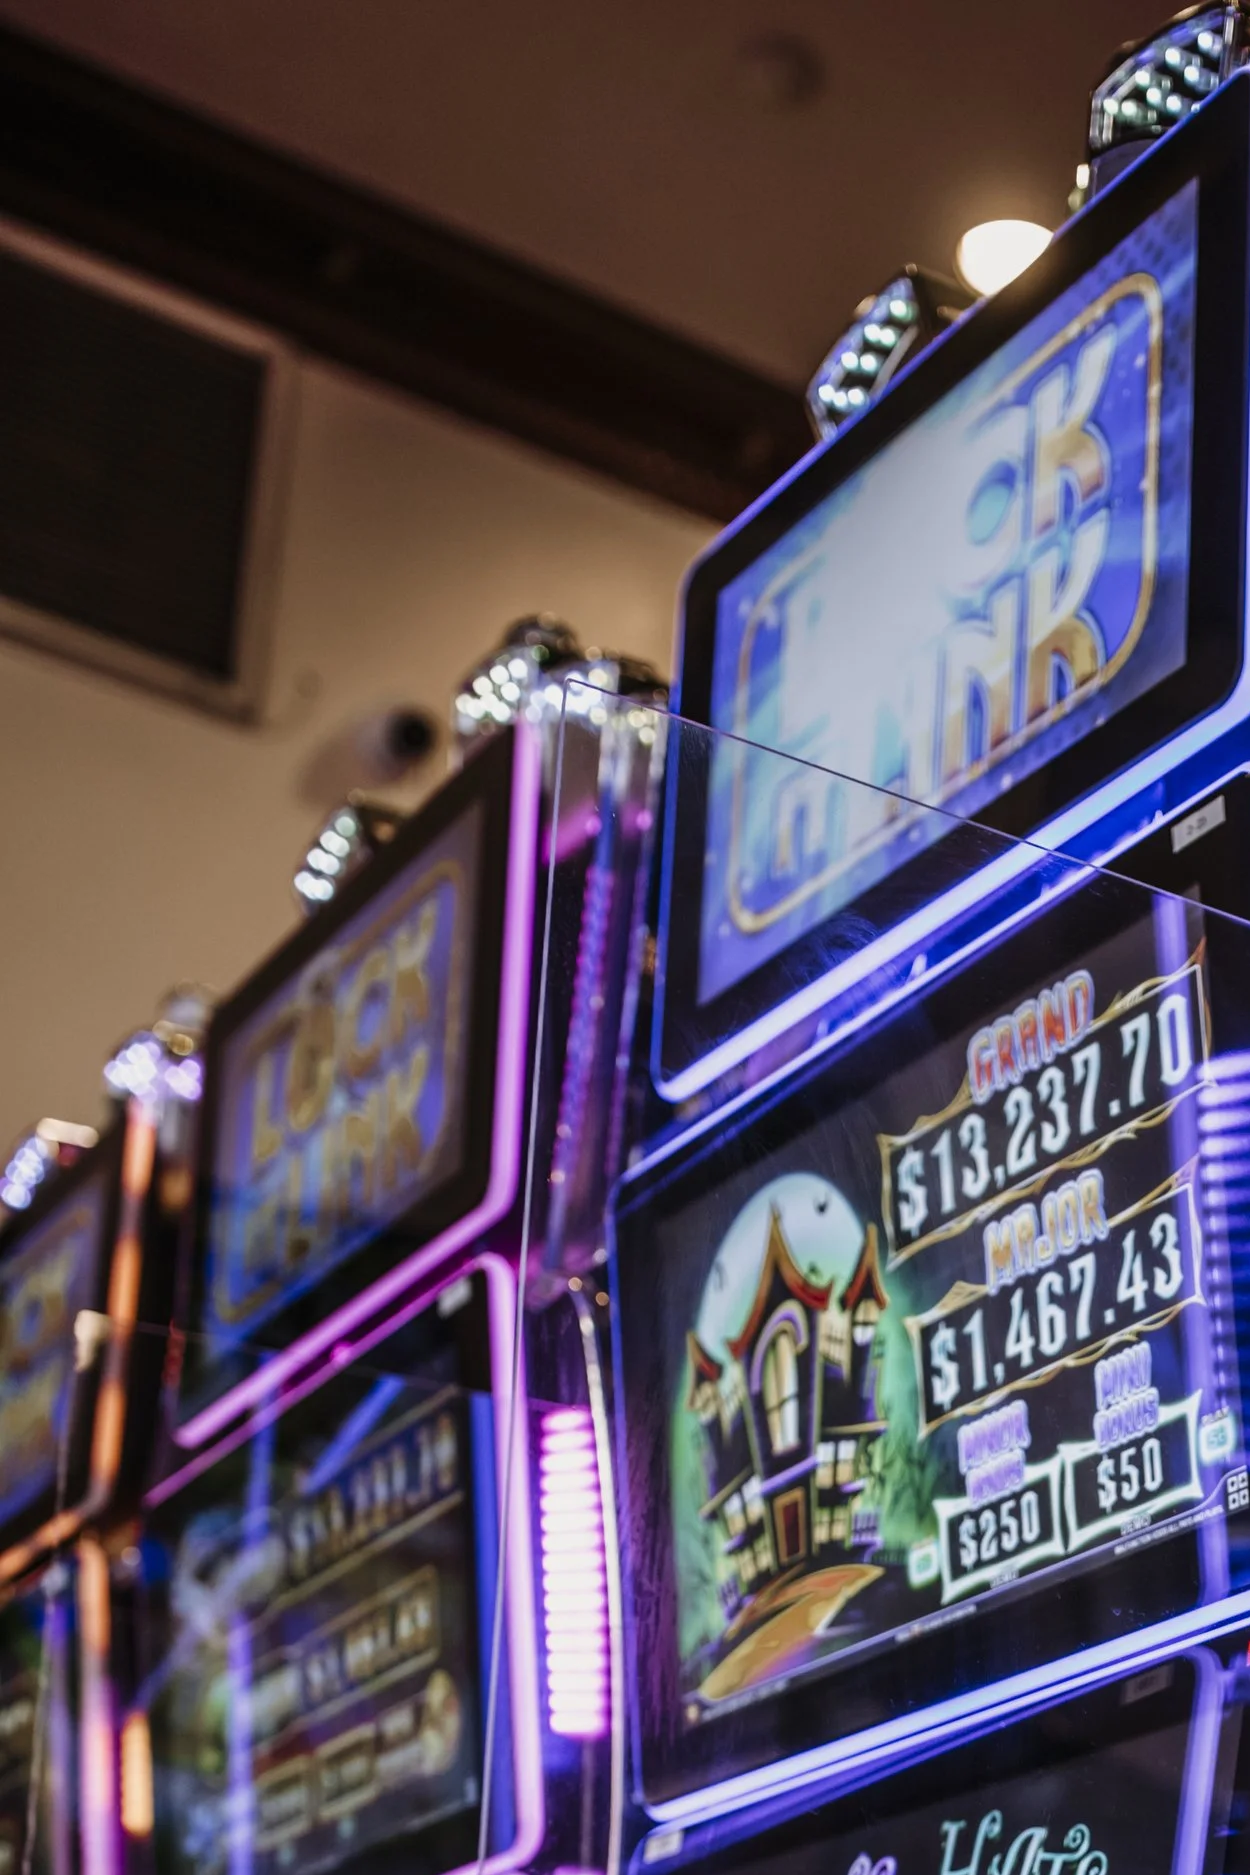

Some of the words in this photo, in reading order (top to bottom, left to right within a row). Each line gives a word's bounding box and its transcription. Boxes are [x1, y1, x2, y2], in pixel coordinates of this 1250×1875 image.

[967, 969, 1095, 1105] GRAND
[897, 993, 1193, 1238] $13,237.70
[984, 1168, 1109, 1296] MAJOR
[930, 1213, 1184, 1410] $1,467.43
[958, 1491, 1040, 1569] $250
[1096, 1438, 1164, 1513] $50
